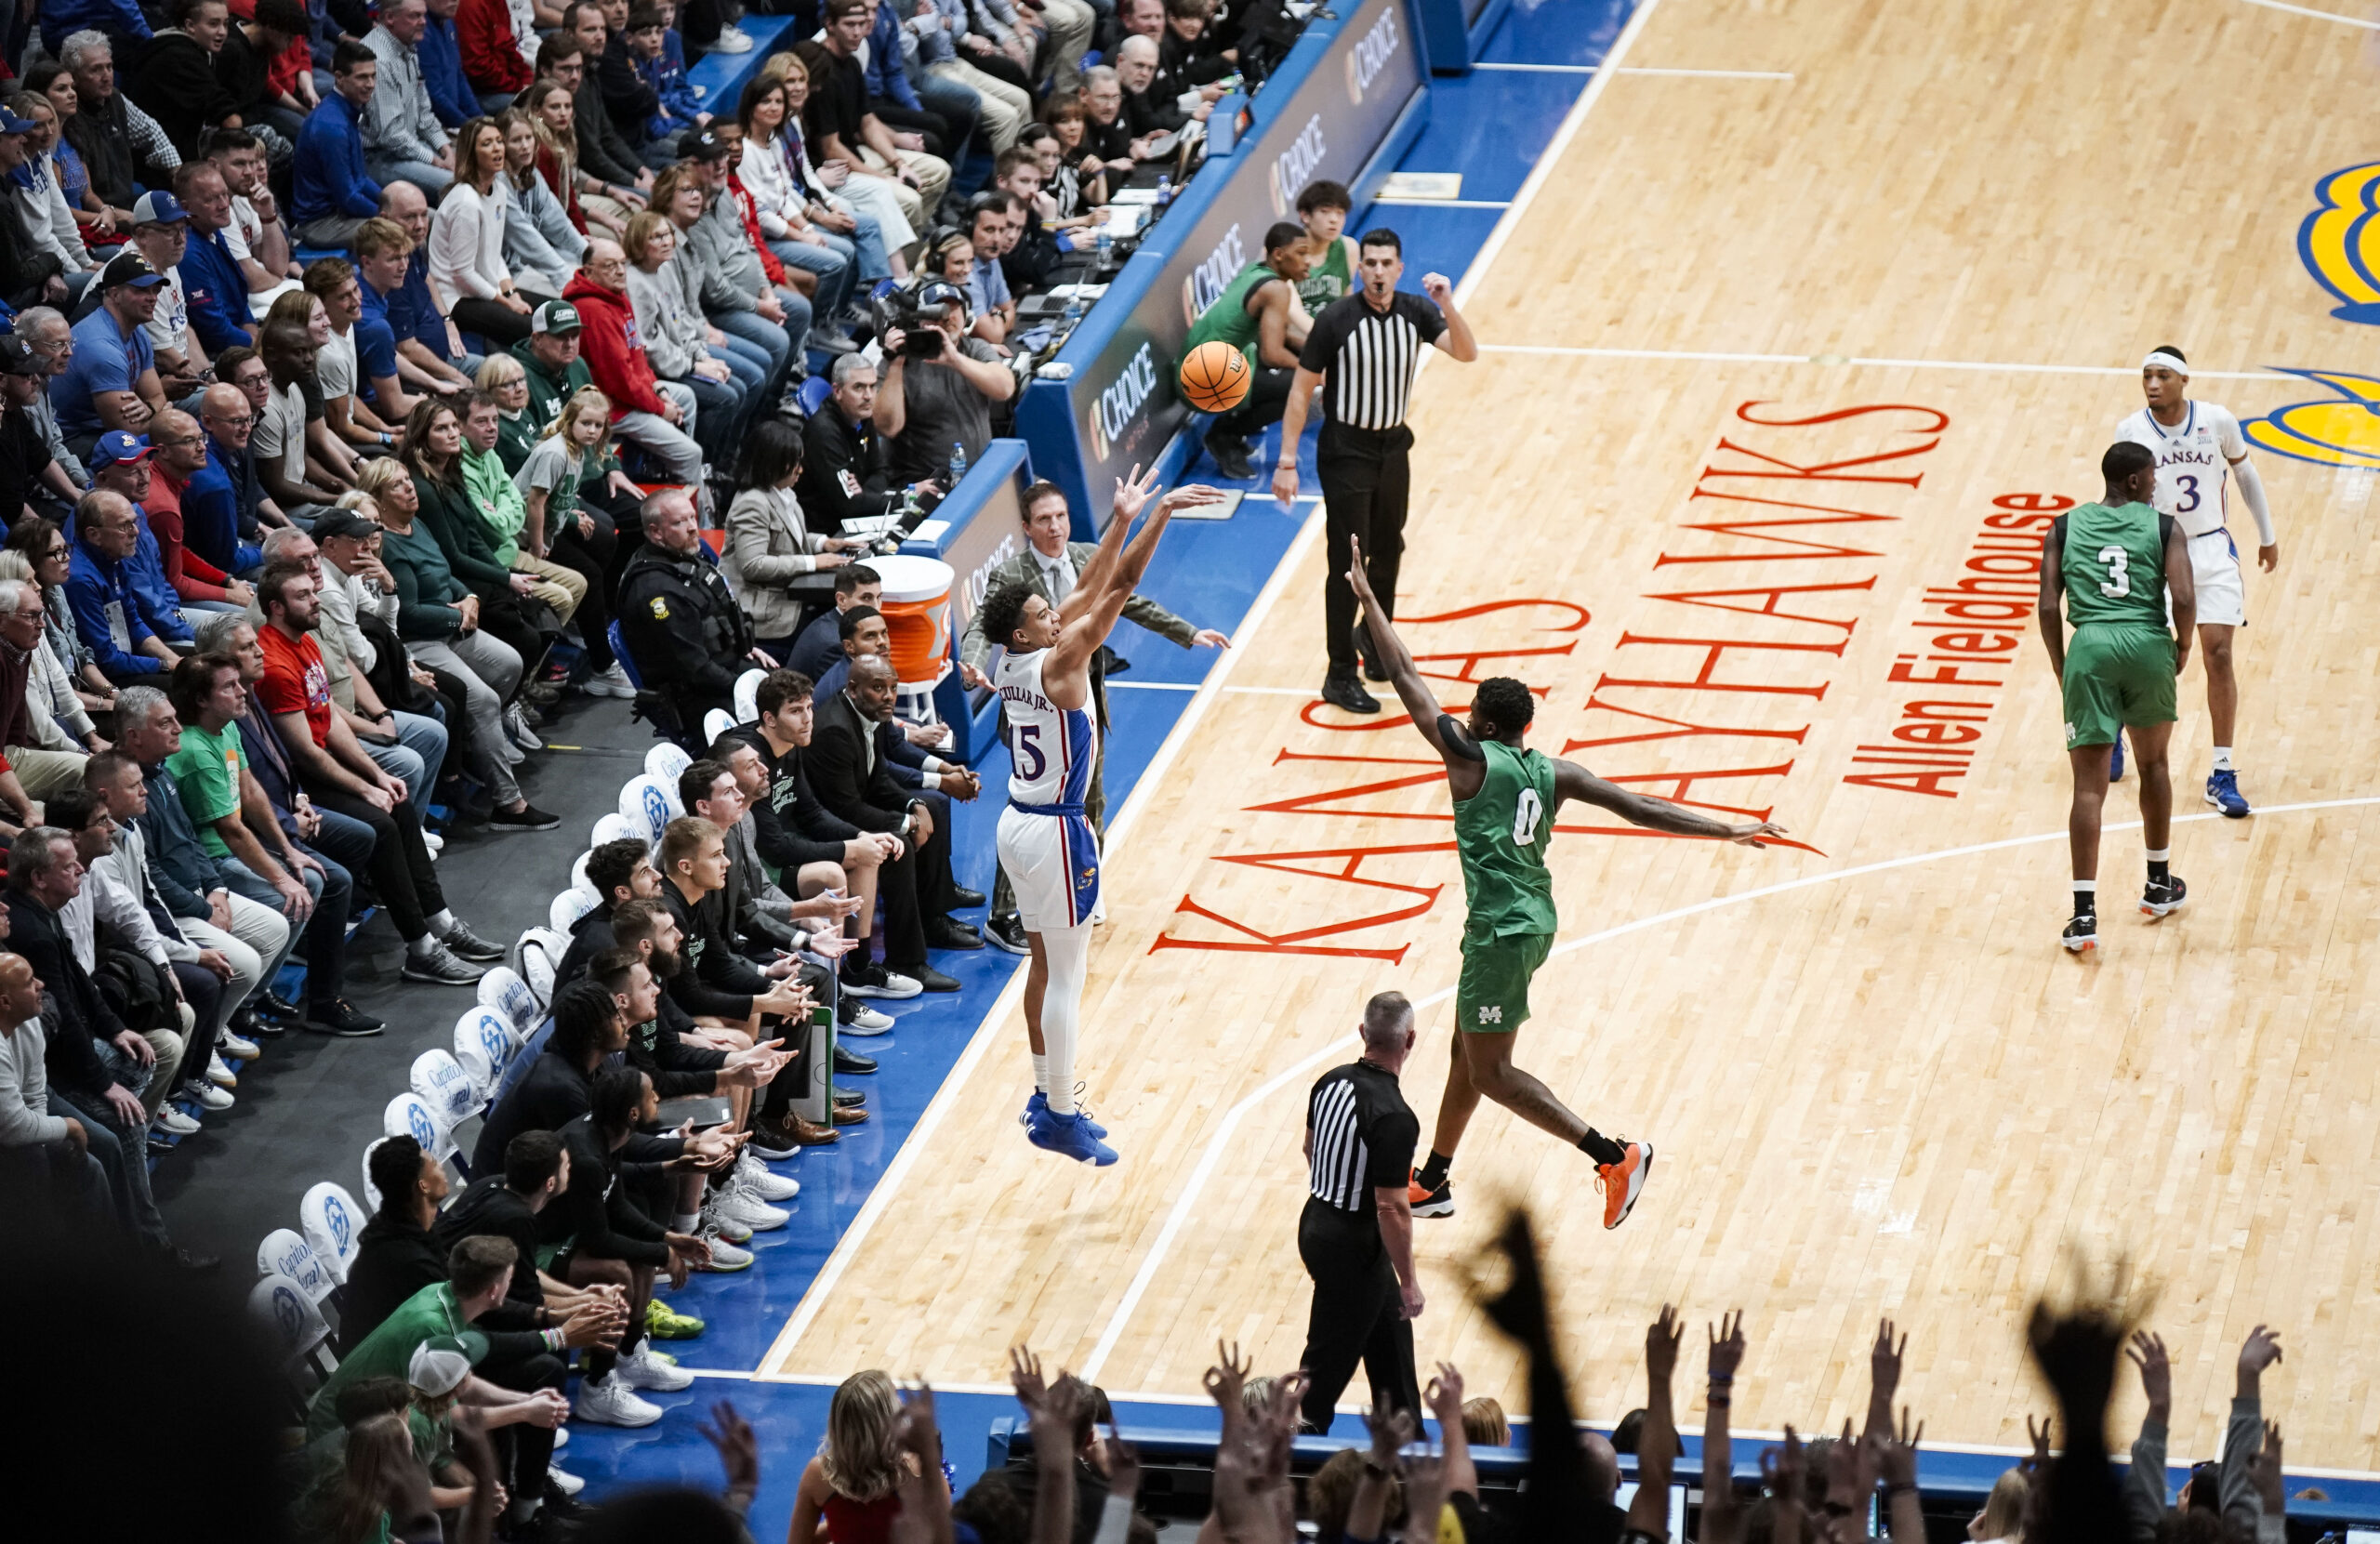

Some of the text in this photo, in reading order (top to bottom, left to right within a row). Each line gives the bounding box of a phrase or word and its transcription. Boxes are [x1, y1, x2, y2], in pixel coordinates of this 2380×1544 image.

[1355, 6, 1399, 89] CHOICE
[1279, 113, 1327, 201] CHOICE
[1102, 341, 1157, 442] CHOICE
[2155, 450, 2214, 468] ANSAS
[2176, 475, 2201, 512] 3
[2098, 545, 2130, 598] 3
[1843, 493, 2076, 798] Allen Fieldhouse
[1009, 723, 1046, 782] 15
[1513, 787, 1543, 847] 0
